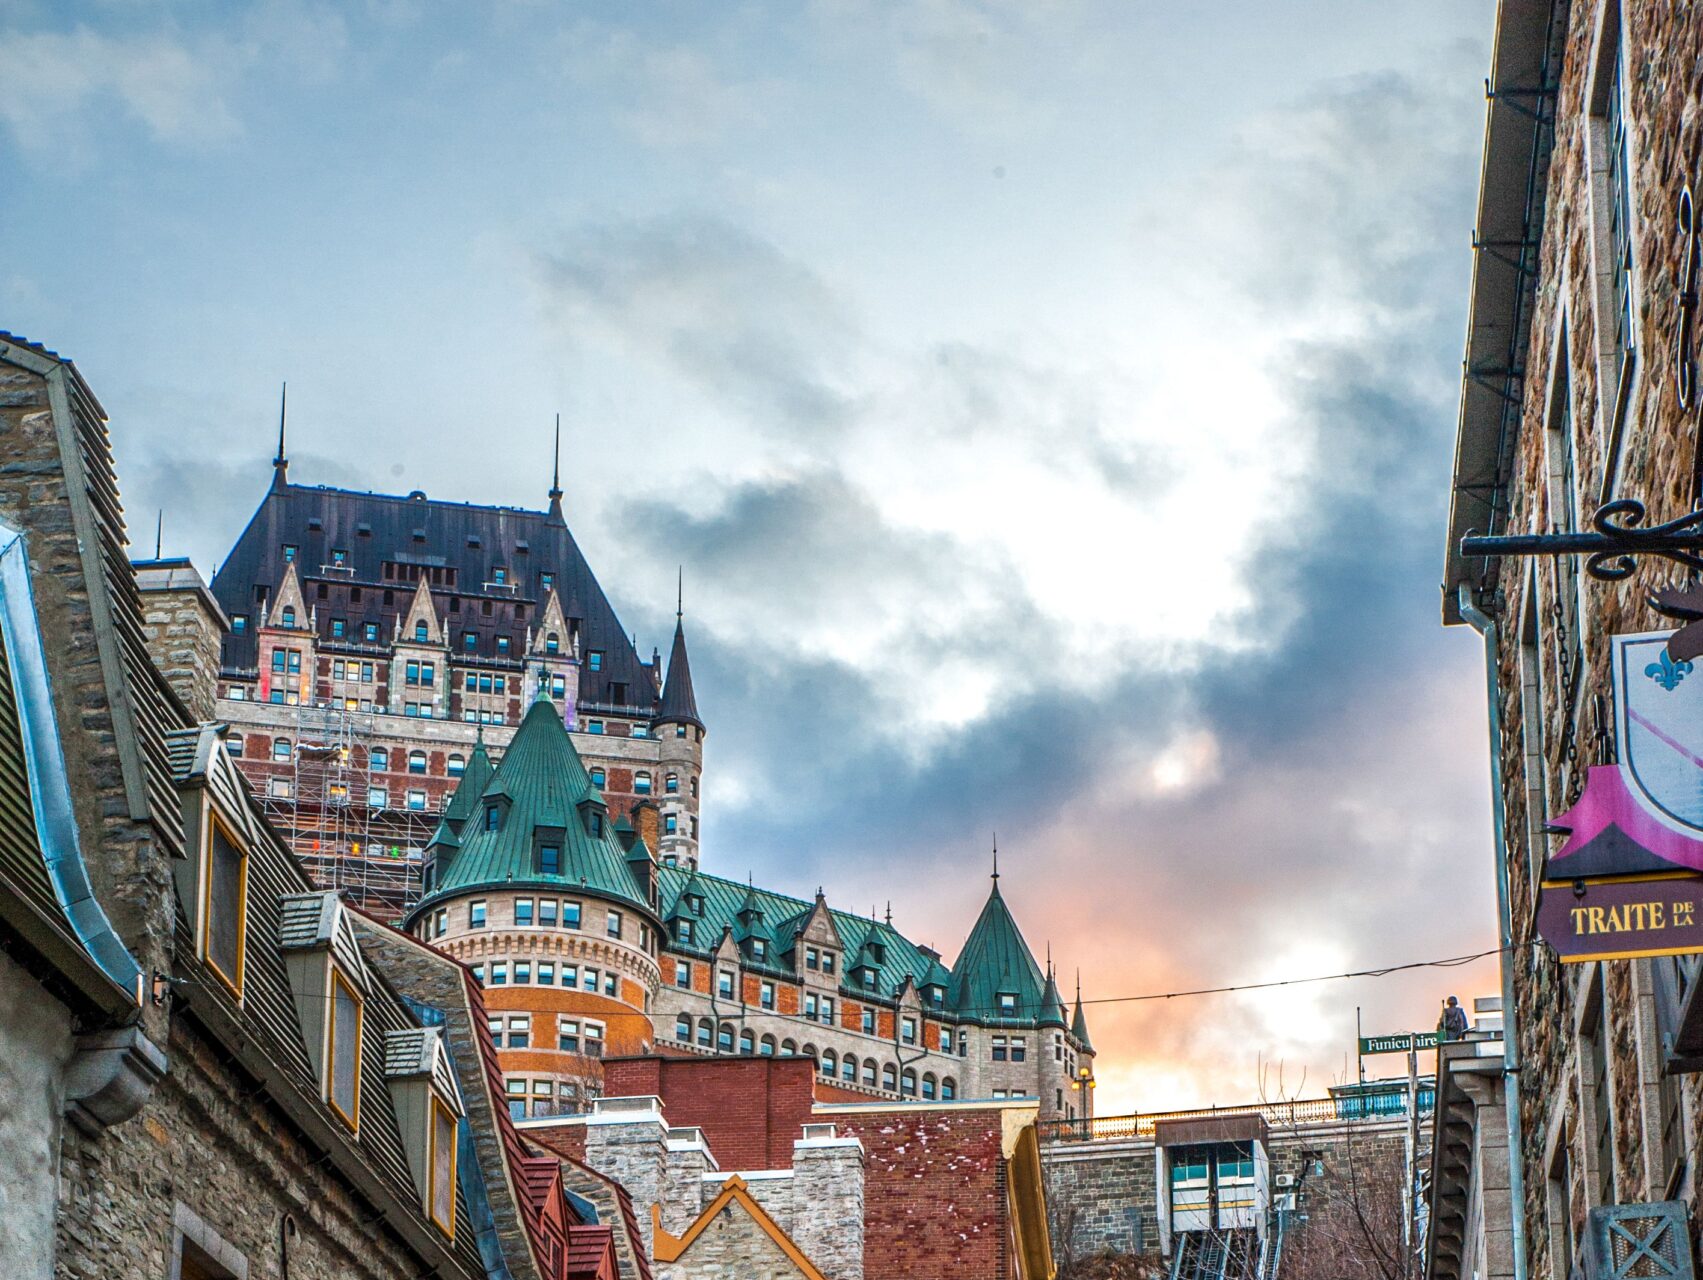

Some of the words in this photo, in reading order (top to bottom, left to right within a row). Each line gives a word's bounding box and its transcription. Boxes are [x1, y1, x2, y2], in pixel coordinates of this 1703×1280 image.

[1673, 901, 1695, 914] DE
[1570, 902, 1667, 935] TRAITE
[1673, 914, 1695, 927] LA
